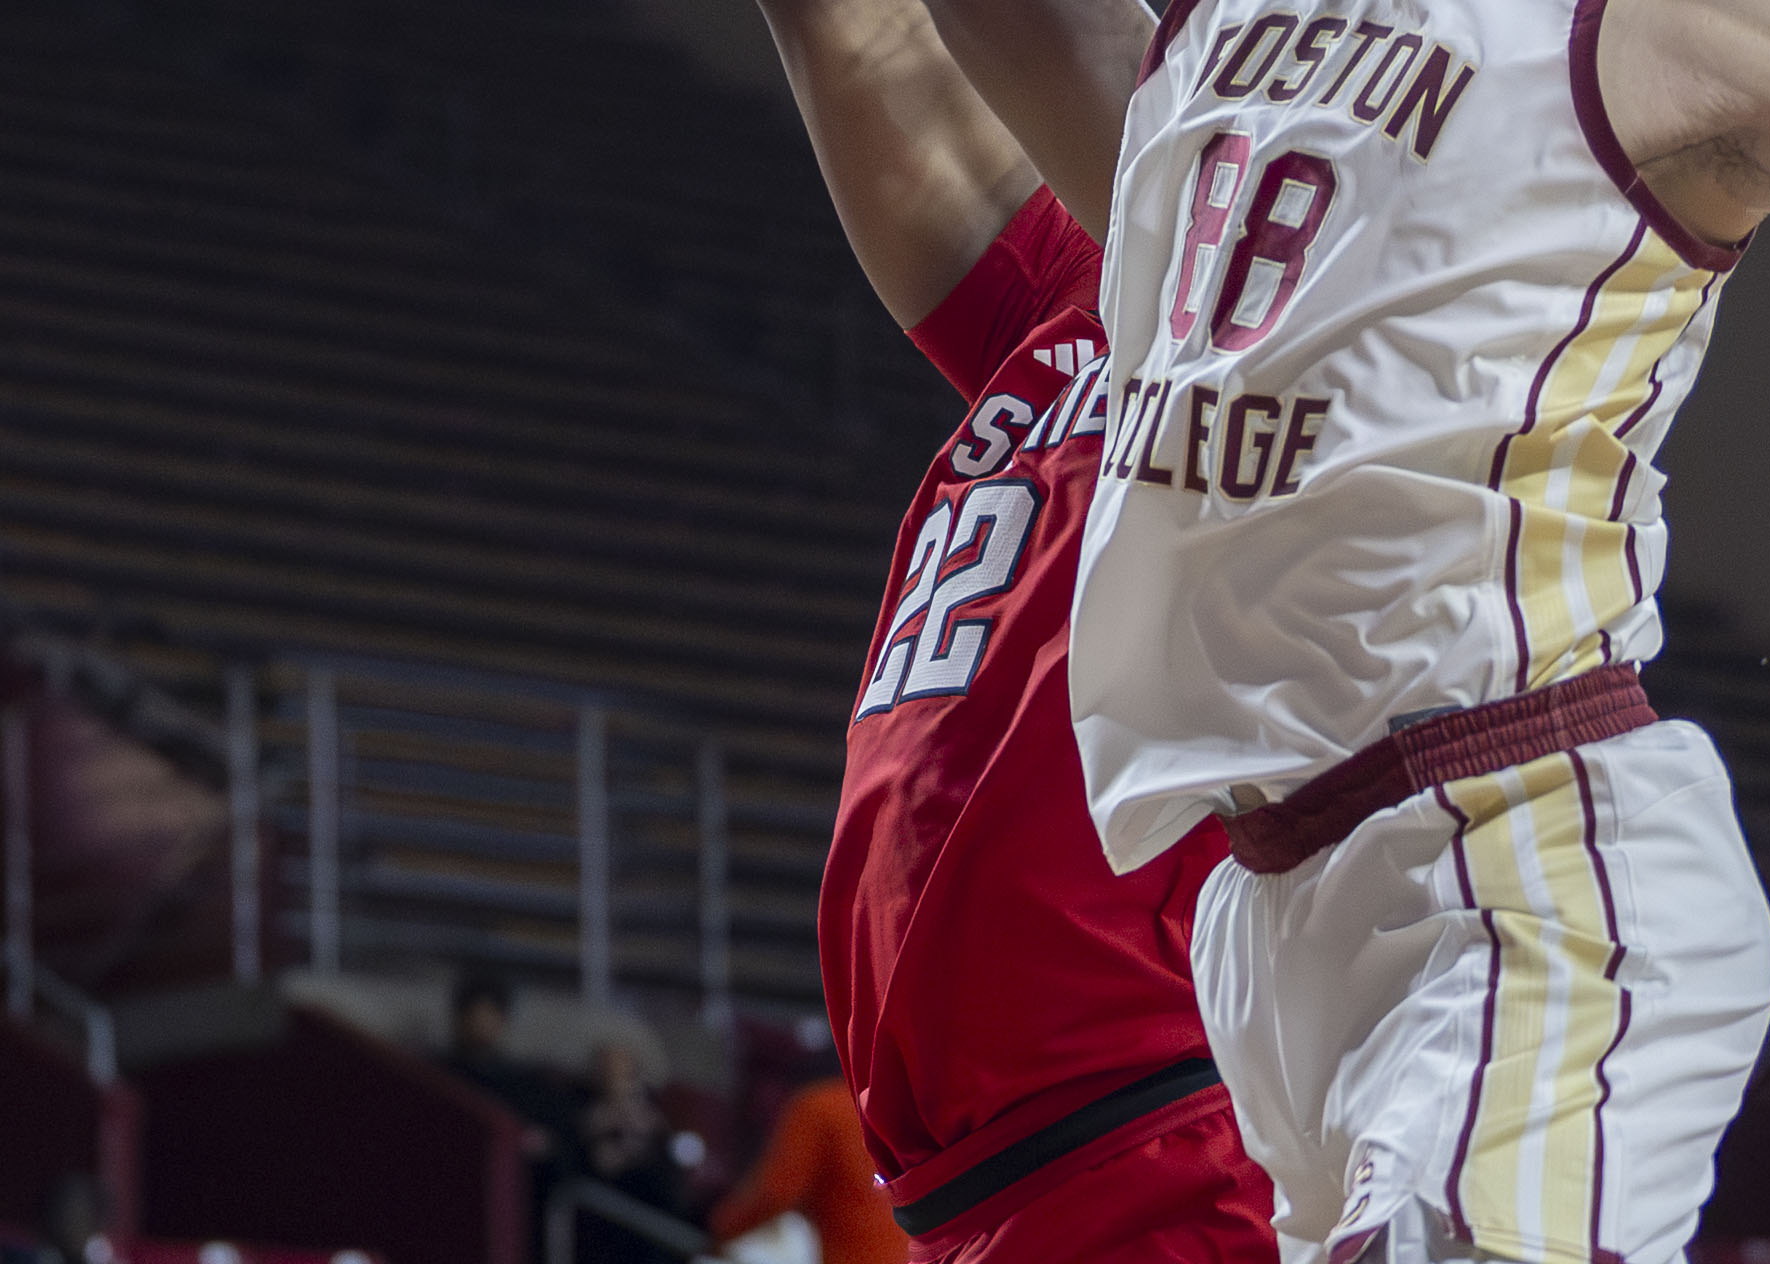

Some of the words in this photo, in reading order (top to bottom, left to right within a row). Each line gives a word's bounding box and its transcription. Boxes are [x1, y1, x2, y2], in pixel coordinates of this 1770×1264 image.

[1169, 131, 1339, 355] 88
[1102, 377, 1332, 501] COLEGE
[853, 477, 1043, 727] 22
